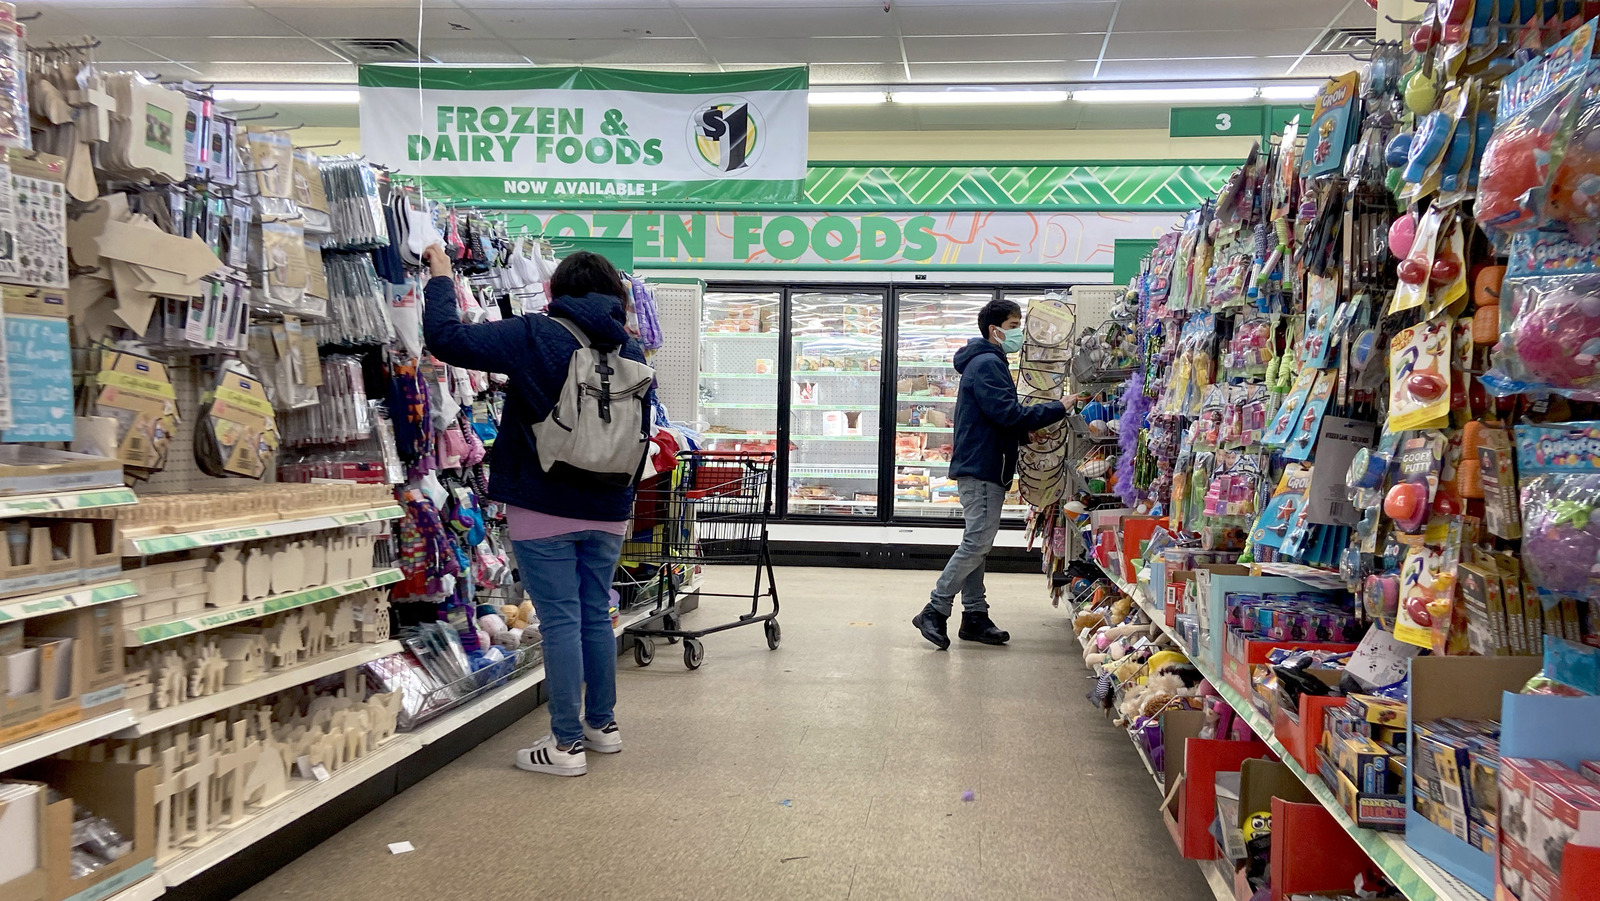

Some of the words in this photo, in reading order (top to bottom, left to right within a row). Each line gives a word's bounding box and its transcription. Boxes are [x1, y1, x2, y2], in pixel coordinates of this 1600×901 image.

[1322, 86, 1347, 107] GROW
[437, 105, 584, 135] FROZEN
[600, 108, 631, 137] &
[1215, 113, 1231, 131] 3
[407, 134, 521, 163] DAIRY
[536, 136, 664, 166] FOODS
[504, 180, 548, 195] NOW
[553, 181, 645, 197] AVAILABLE
[732, 214, 938, 262] FOODS
[1403, 450, 1432, 462] GOOFY
[1404, 461, 1431, 473] PUTTY
[1361, 805, 1406, 819] BLOCKS
